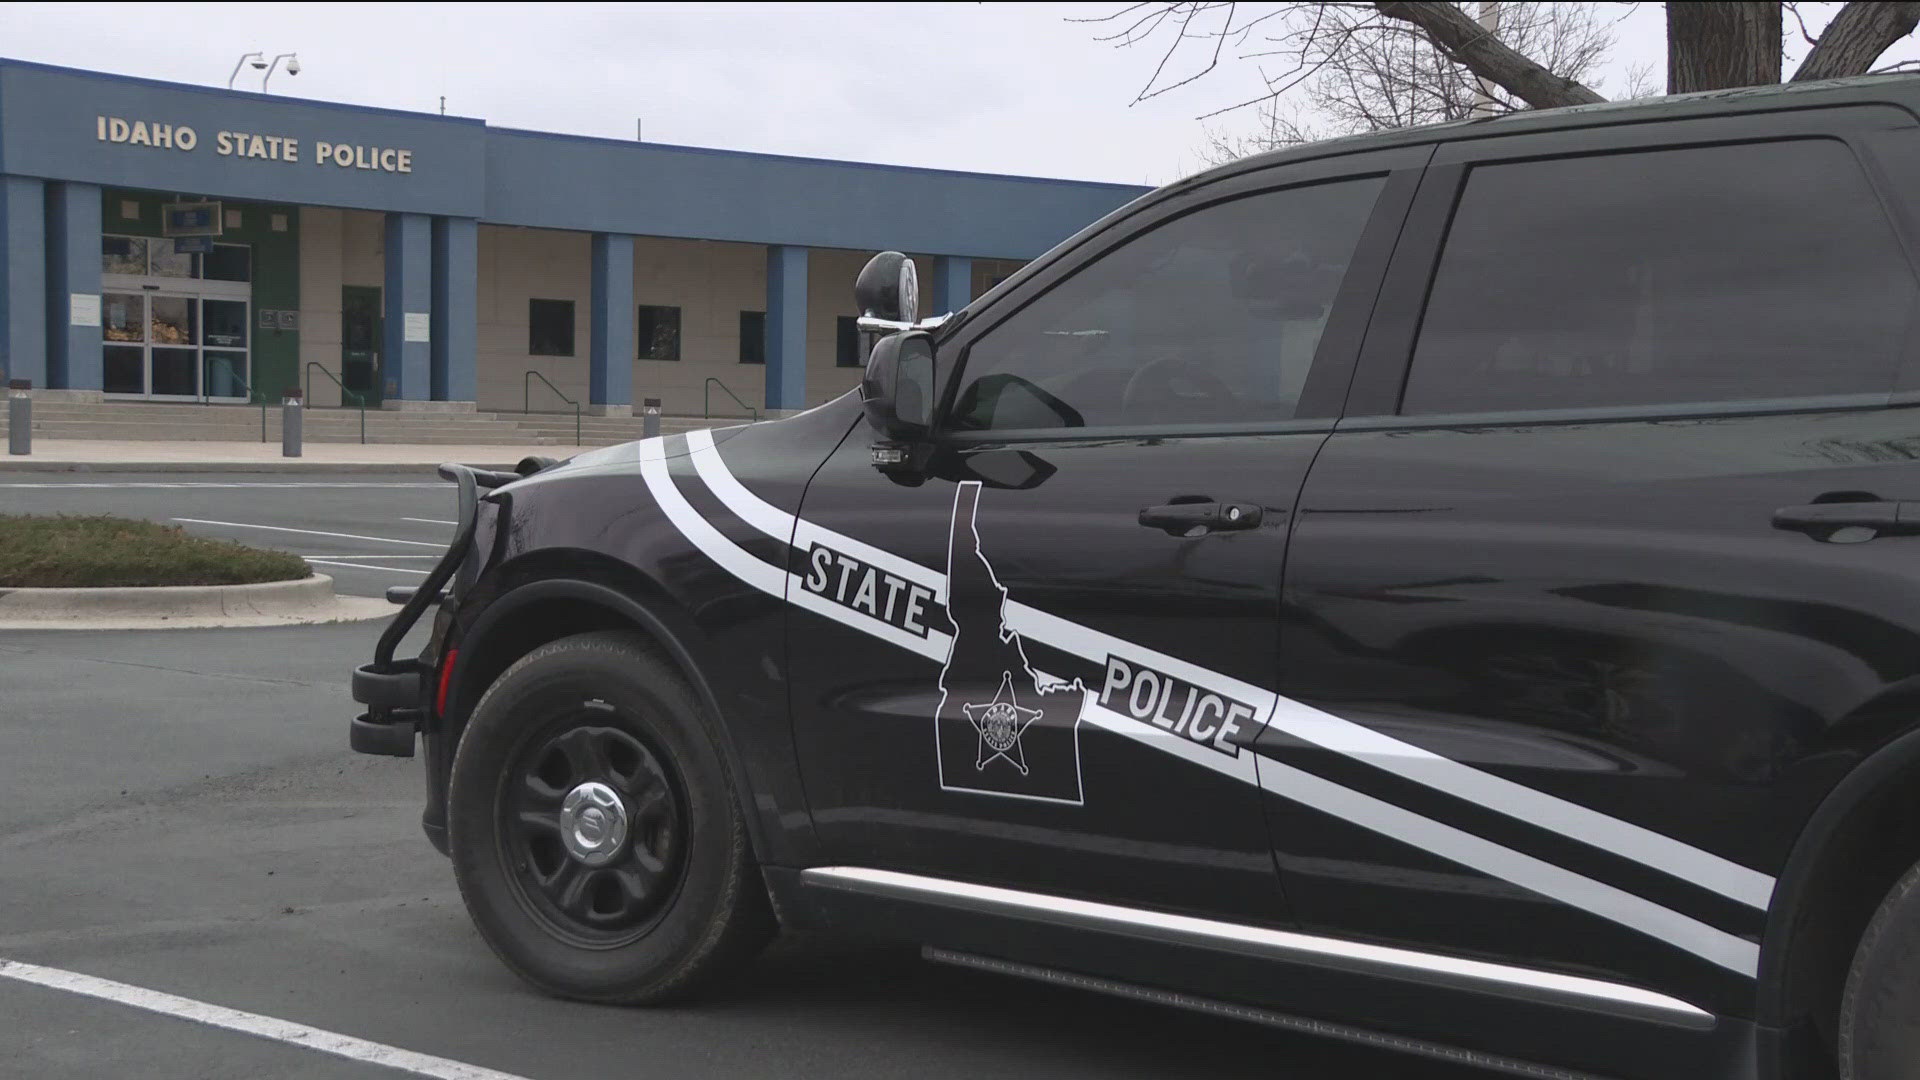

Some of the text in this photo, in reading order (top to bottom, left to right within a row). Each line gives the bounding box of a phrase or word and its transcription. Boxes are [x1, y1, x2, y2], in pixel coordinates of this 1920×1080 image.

[97, 115, 412, 173] IDAHO STATE POLICE
[806, 547, 932, 635] STATE
[1100, 656, 1254, 755] POLICE
